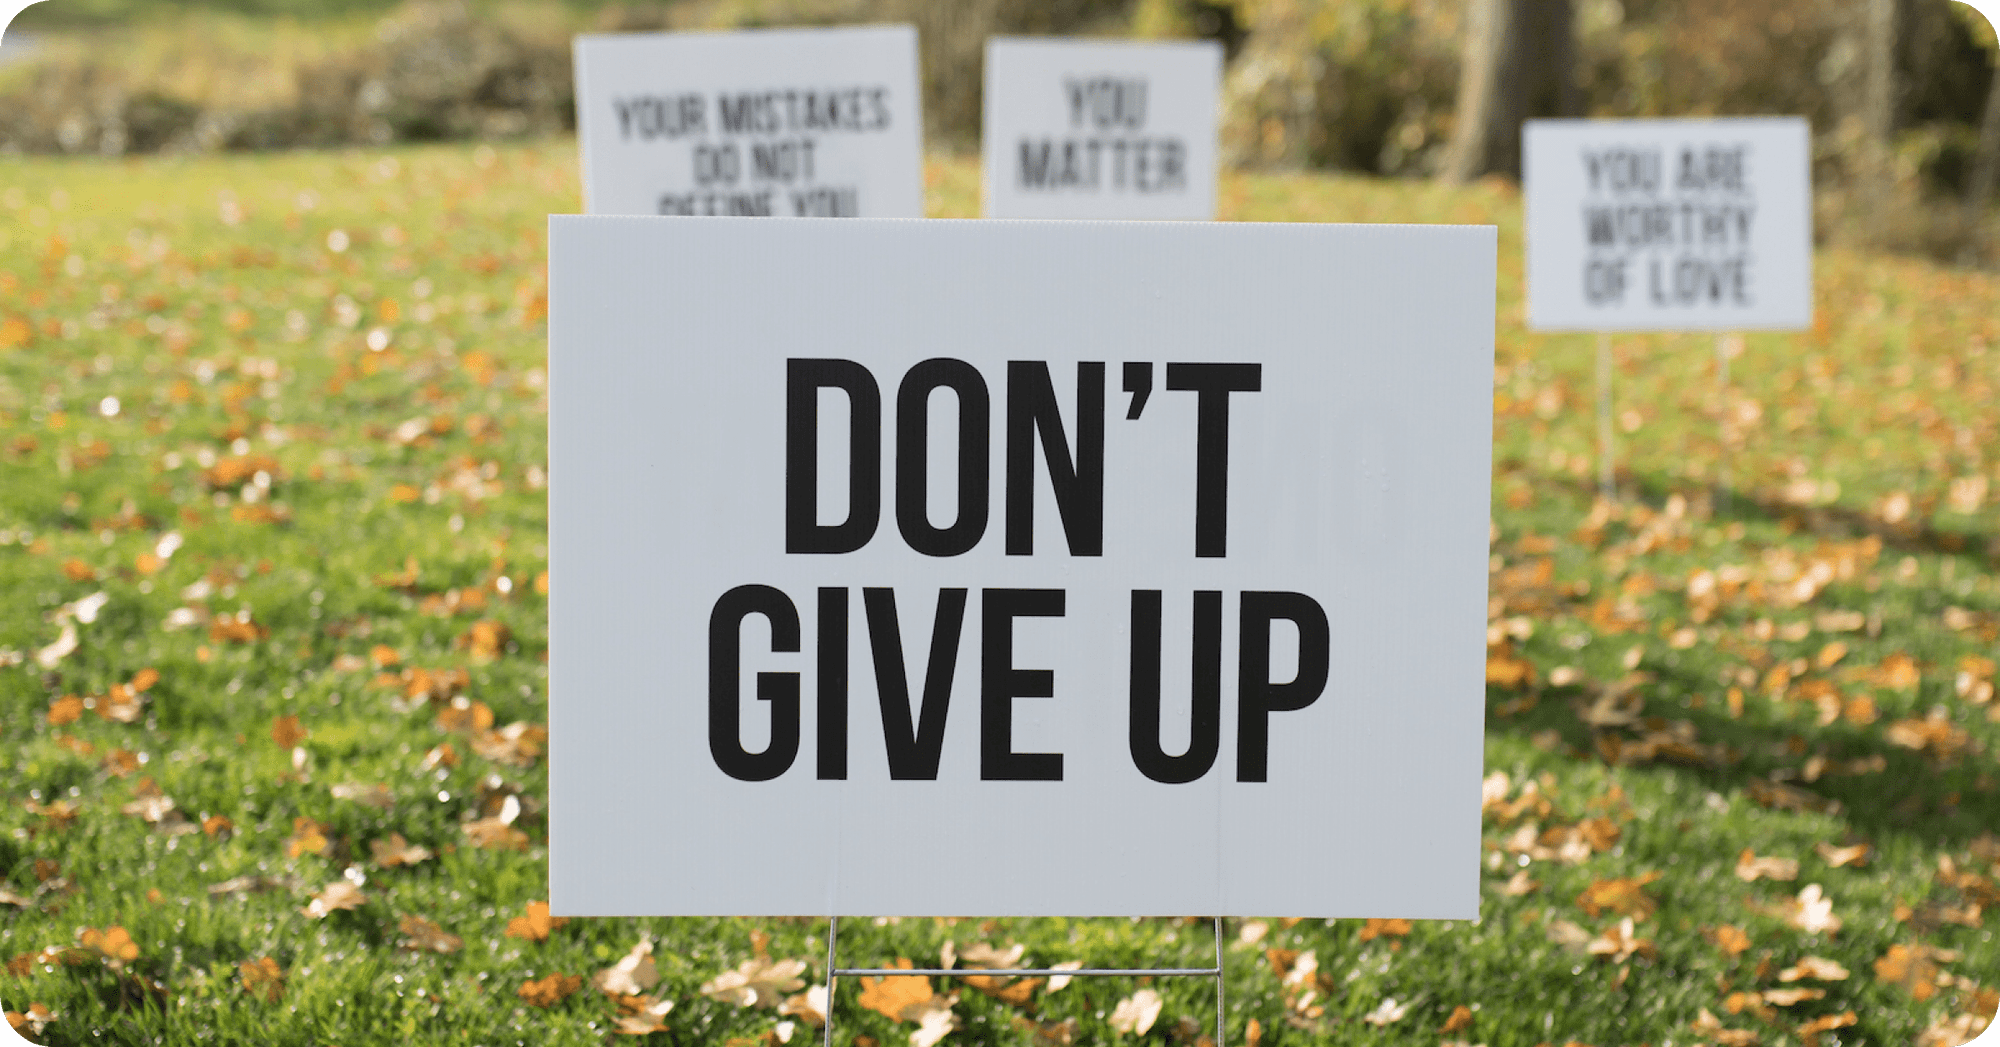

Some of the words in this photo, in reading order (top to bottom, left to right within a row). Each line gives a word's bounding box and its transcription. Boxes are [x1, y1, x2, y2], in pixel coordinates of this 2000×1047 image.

[614, 93, 707, 138] YOUR
[718, 87, 891, 134] MISTAKES
[1062, 74, 1148, 128] YOU
[693, 144, 740, 185] DO
[751, 139, 815, 181] NOT
[1018, 138, 1188, 189] MATTER
[1581, 147, 1662, 191] YOU
[1674, 144, 1752, 190] ARE
[1582, 203, 1756, 247] WORTHY
[1585, 256, 1628, 304] OF
[1649, 255, 1752, 304] LOVE
[785, 357, 1262, 559] DON’T
[708, 583, 1066, 782] GIVE
[1128, 589, 1330, 785] UP
